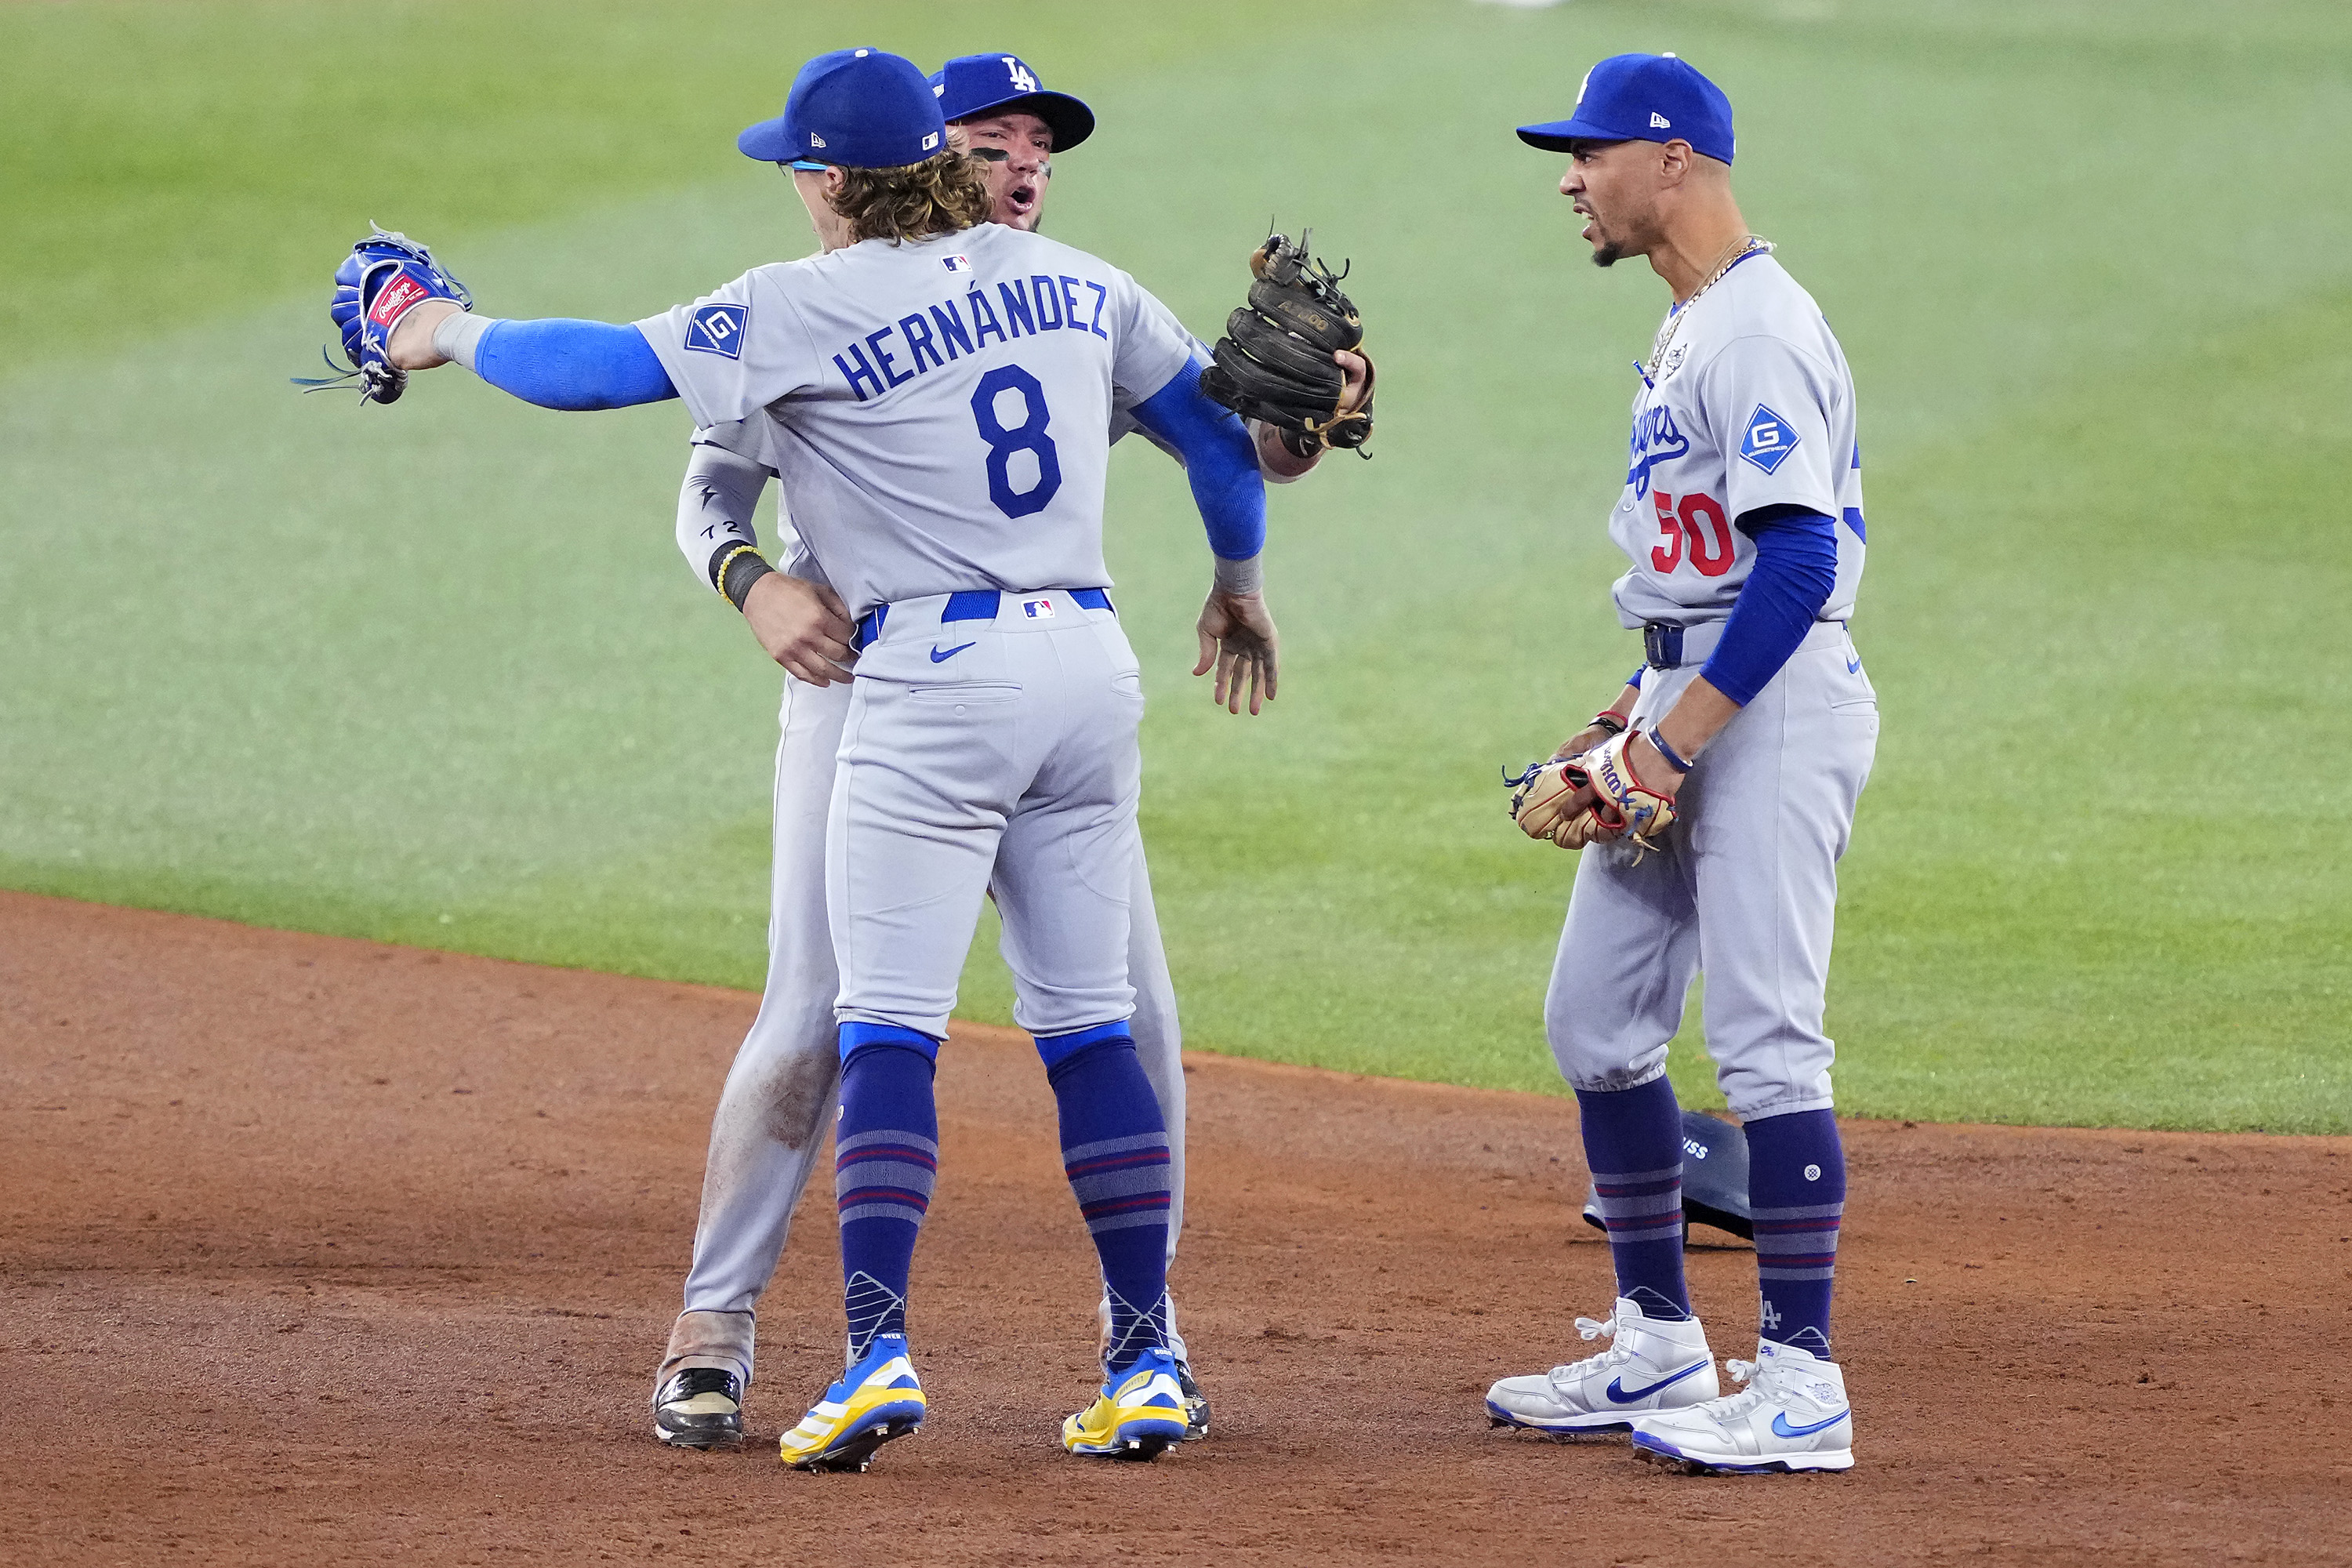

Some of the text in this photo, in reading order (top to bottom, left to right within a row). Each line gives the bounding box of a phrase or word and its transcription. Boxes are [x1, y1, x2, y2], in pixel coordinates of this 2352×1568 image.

[1001, 57, 1037, 92] LA
[379, 282, 411, 319] Rawlings
[706, 310, 738, 339] G
[832, 275, 1107, 401] HERNÁNDEZ
[971, 364, 1062, 519] 8
[1751, 422, 1780, 448] G
[1650, 488, 1735, 576] 50
